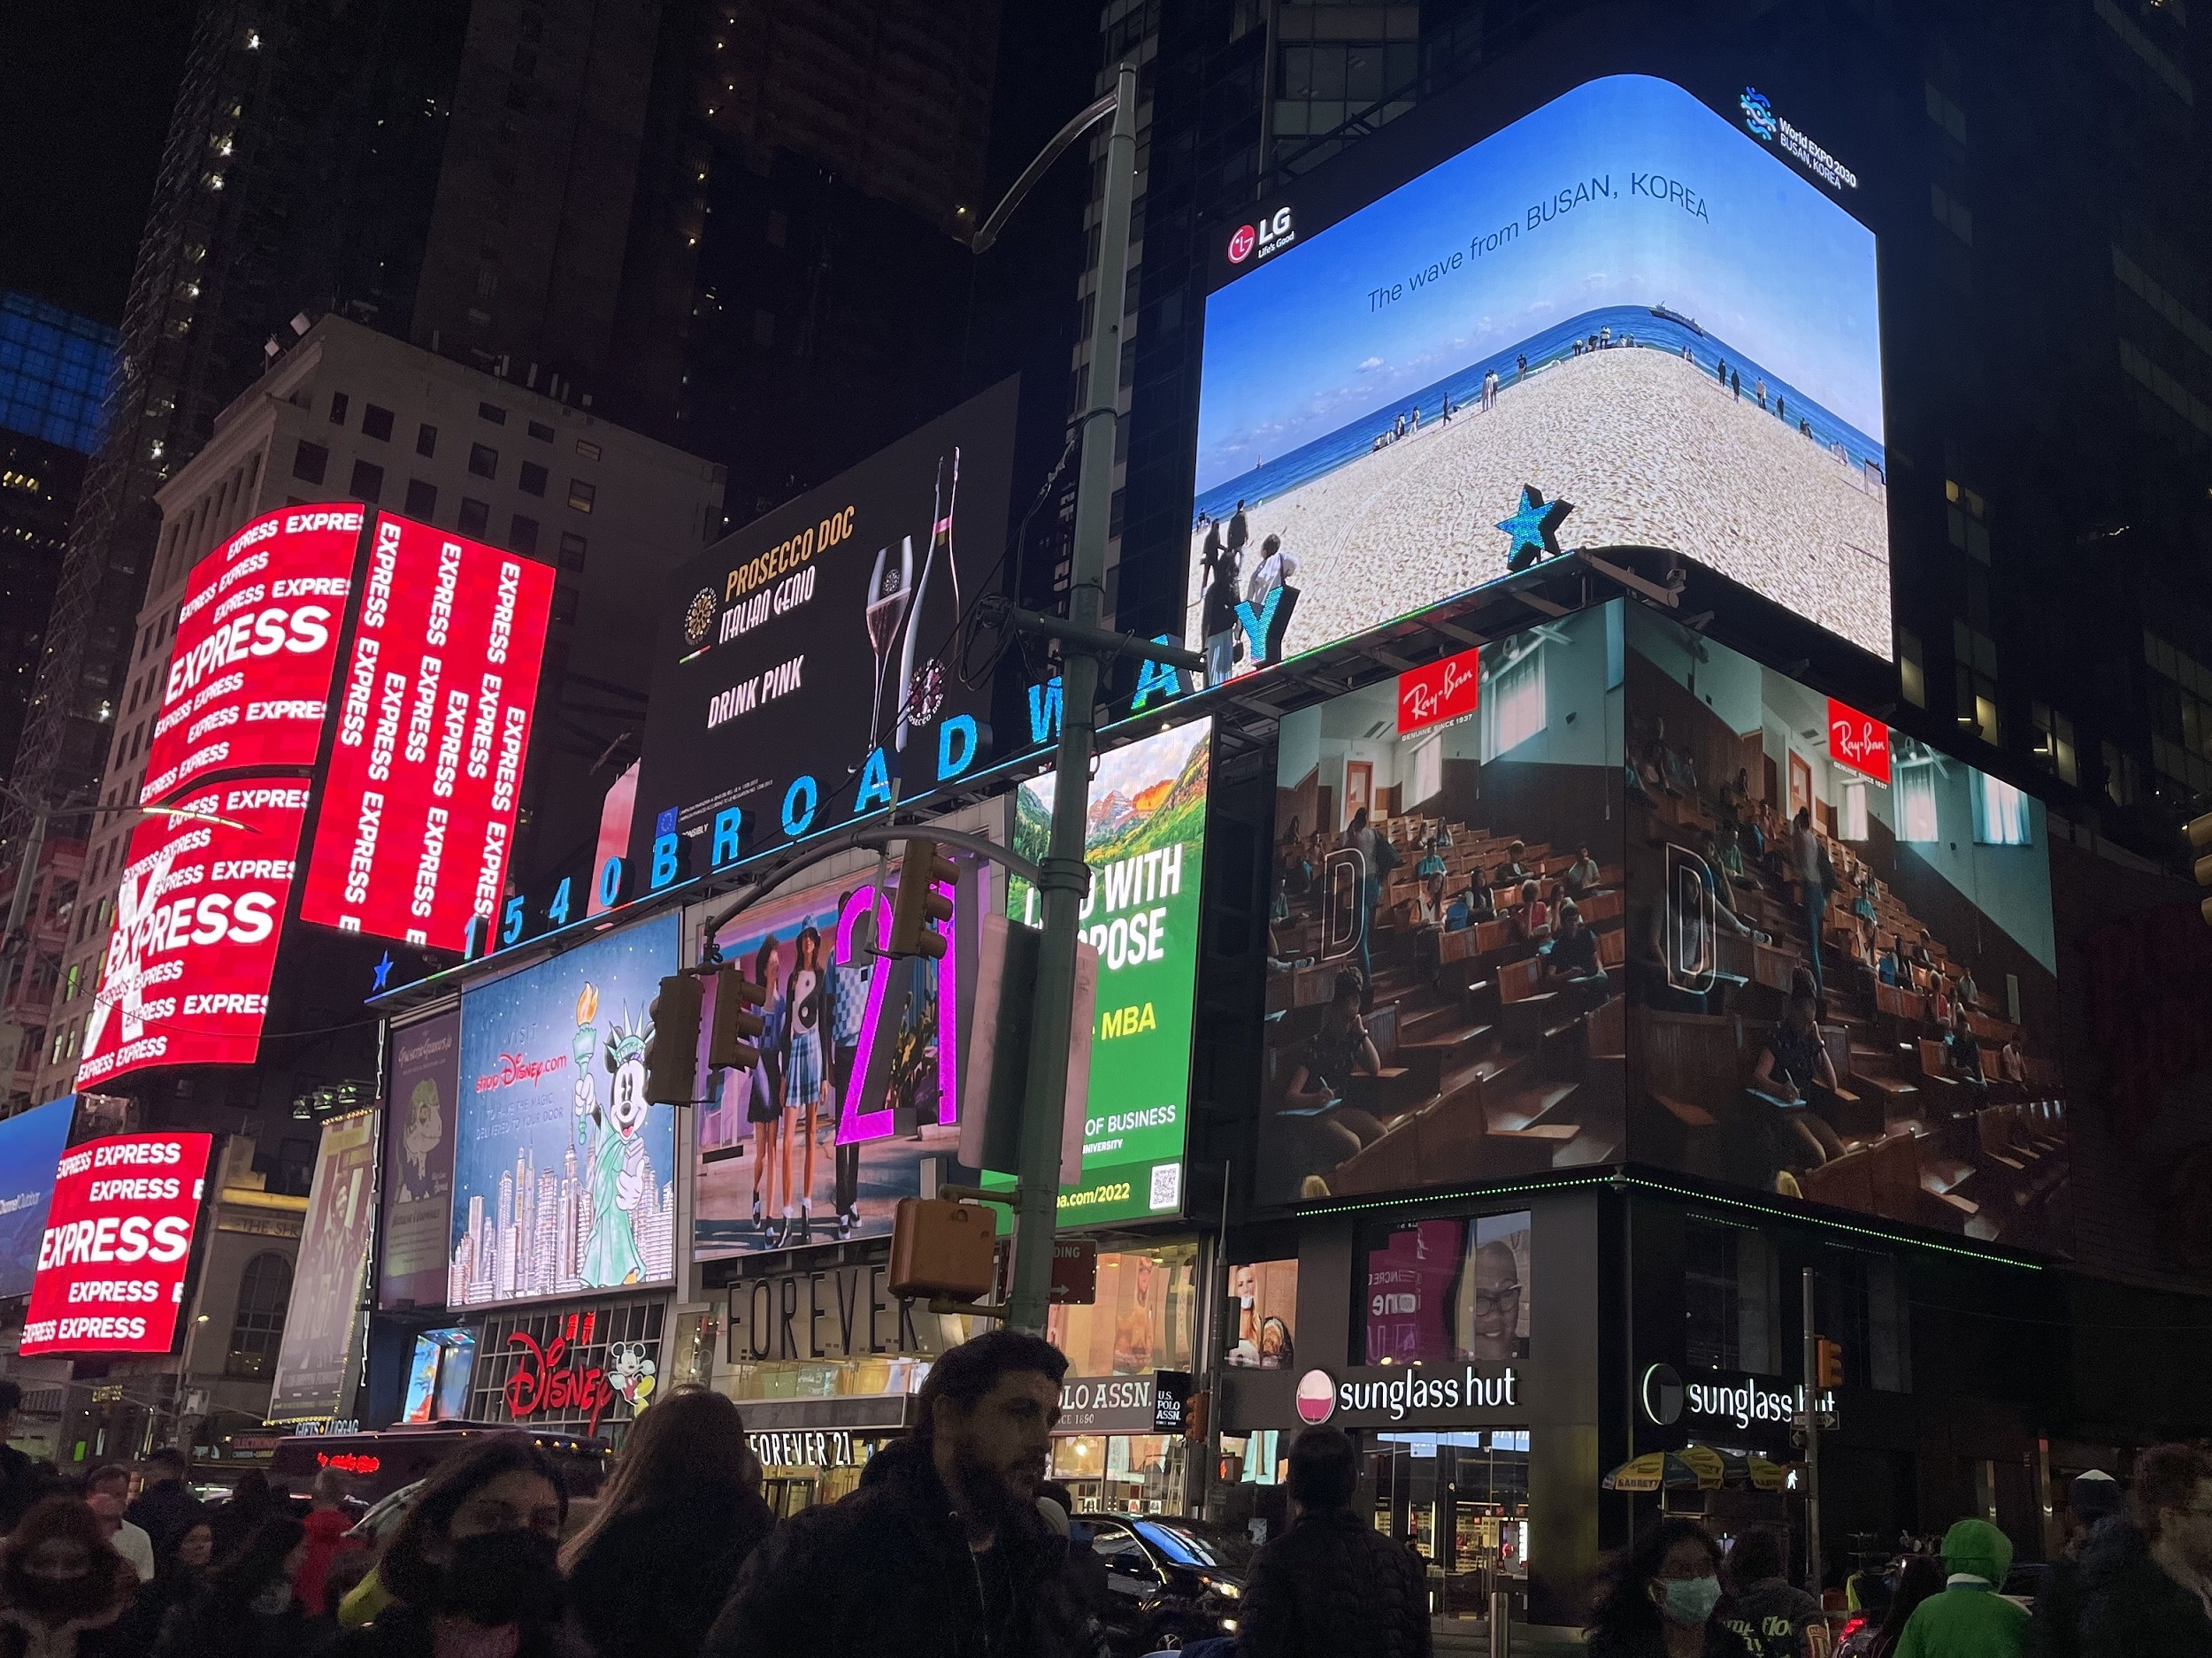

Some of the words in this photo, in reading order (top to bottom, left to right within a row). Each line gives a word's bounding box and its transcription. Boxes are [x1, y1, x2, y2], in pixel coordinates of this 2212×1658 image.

[1779, 117, 1808, 149] World
[1809, 140, 1833, 169] EXPO
[1834, 161, 1857, 188] 2030
[1780, 133, 1812, 169] BUSAN,
[1813, 158, 1842, 190] KOREA
[1258, 242, 1276, 259] Life's
[1276, 230, 1294, 249] Good
[1259, 206, 1291, 246] LG
[1367, 283, 1402, 313] The
[1409, 250, 1463, 291] wave
[1470, 221, 1519, 262] from
[1526, 173, 1618, 232] BUSAN,
[1631, 172, 1709, 225] KOREA
[226, 518, 280, 562] EXPRESS
[286, 513, 364, 533] EXPRE
[725, 528, 813, 603] PROSECCO
[817, 504, 855, 554] DOC
[179, 581, 218, 625] EXPRESS
[219, 550, 270, 594] EXPRESS
[212, 583, 266, 625] EXPRESS
[272, 578, 352, 599] EXPRE
[364, 521, 402, 628] EXPRESS
[426, 541, 463, 648] EXPRESS
[487, 561, 521, 664] EXPRESS
[719, 588, 772, 645] ITALIAN
[165, 605, 332, 707] EXPRESS
[154, 699, 193, 740] EXPRESS
[193, 672, 245, 712] EXPRESS
[341, 637, 380, 748] EXPRESS
[405, 655, 442, 764] EXPRESS
[707, 676, 757, 728] DRINK
[761, 654, 804, 703] PINK
[1402, 661, 1473, 721] Ray-Ban
[187, 705, 240, 744] EXPRESS
[245, 700, 327, 722] EXPRE
[368, 672, 407, 781] EXPRESS
[432, 689, 470, 798] EXPRESS
[467, 672, 503, 779] EXPRESS
[1402, 726, 1432, 742] GENUINE
[1433, 719, 1454, 733] SINCE
[1455, 713, 1473, 725] 1937
[1832, 720, 1886, 763] Ray-Ban
[139, 766, 179, 804] EXPRESS
[179, 741, 230, 780] EXPRESS
[491, 705, 526, 812] EXPRESS
[345, 791, 385, 904] EXPRESS
[411, 806, 449, 918] EXPRESS
[473, 820, 507, 923] EXPRES
[1104, 842, 1184, 913] WITH
[104, 891, 277, 979] EXPRESS
[133, 959, 185, 991] EXPRESS
[508, 1023, 537, 1046] VISIT
[1101, 1002, 1156, 1040] MBA
[78, 1051, 116, 1083] EXPRESS
[116, 1035, 168, 1067] EXPRESS
[476, 1120, 510, 1140] DELIVERED
[512, 1117, 520, 1130] TO
[523, 1112, 541, 1126] YOUR
[542, 1107, 564, 1122] DOOR
[517, 1098, 529, 1111] THE
[531, 1092, 554, 1109] MAGIC
[1085, 1117, 1104, 1137] OF
[1108, 1104, 1176, 1132] BUSINESS
[57, 1150, 93, 1179] EXPRESS
[95, 1142, 181, 1167] EXPRESS
[89, 1178, 180, 1202] EXPRESS
[36, 1216, 191, 1272] EXPRESS
[68, 1280, 159, 1303] EXPRESS
[727, 1263, 919, 1364] FOREVER
[58, 1316, 147, 1339] EXPRESS
[1092, 1381, 1152, 1409] ASSN.
[1156, 1409, 1182, 1421] ASSN.
[1157, 1400, 1180, 1411] POLO
[1158, 1390, 1173, 1401] U.S.
[1340, 1368, 1459, 1421] sunglass
[1466, 1365, 1516, 1407] hut
[1688, 1378, 1793, 1430] sunglass
[749, 1431, 828, 1466] FOREVER
[833, 1432, 854, 1466] 21
